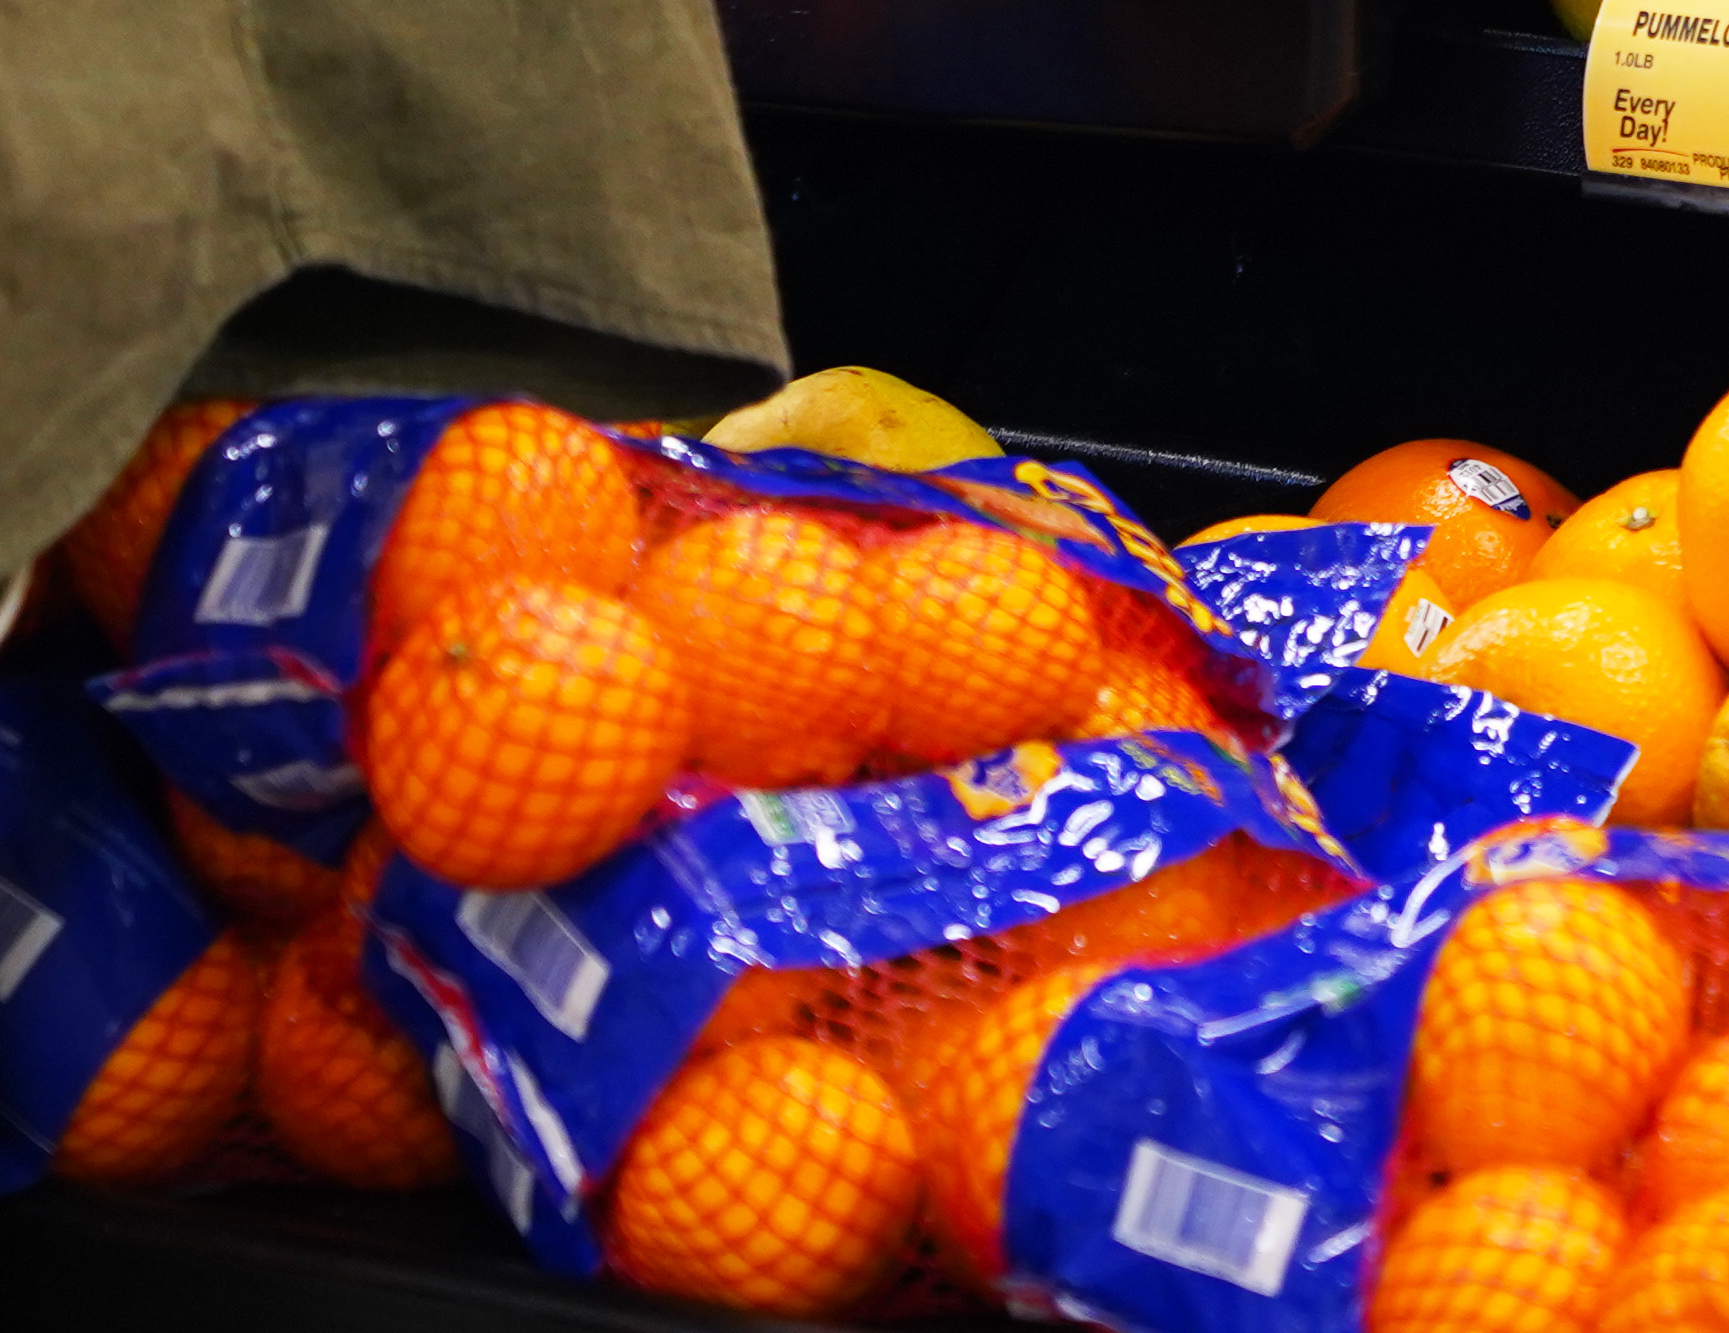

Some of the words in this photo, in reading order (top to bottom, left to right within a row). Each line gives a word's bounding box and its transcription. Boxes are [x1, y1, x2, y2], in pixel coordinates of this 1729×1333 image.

[1614, 51, 1654, 69] 1.0LB
[1614, 89, 1675, 119] Every
[1620, 116, 1668, 146] Day!
[1612, 155, 1633, 169] 329
